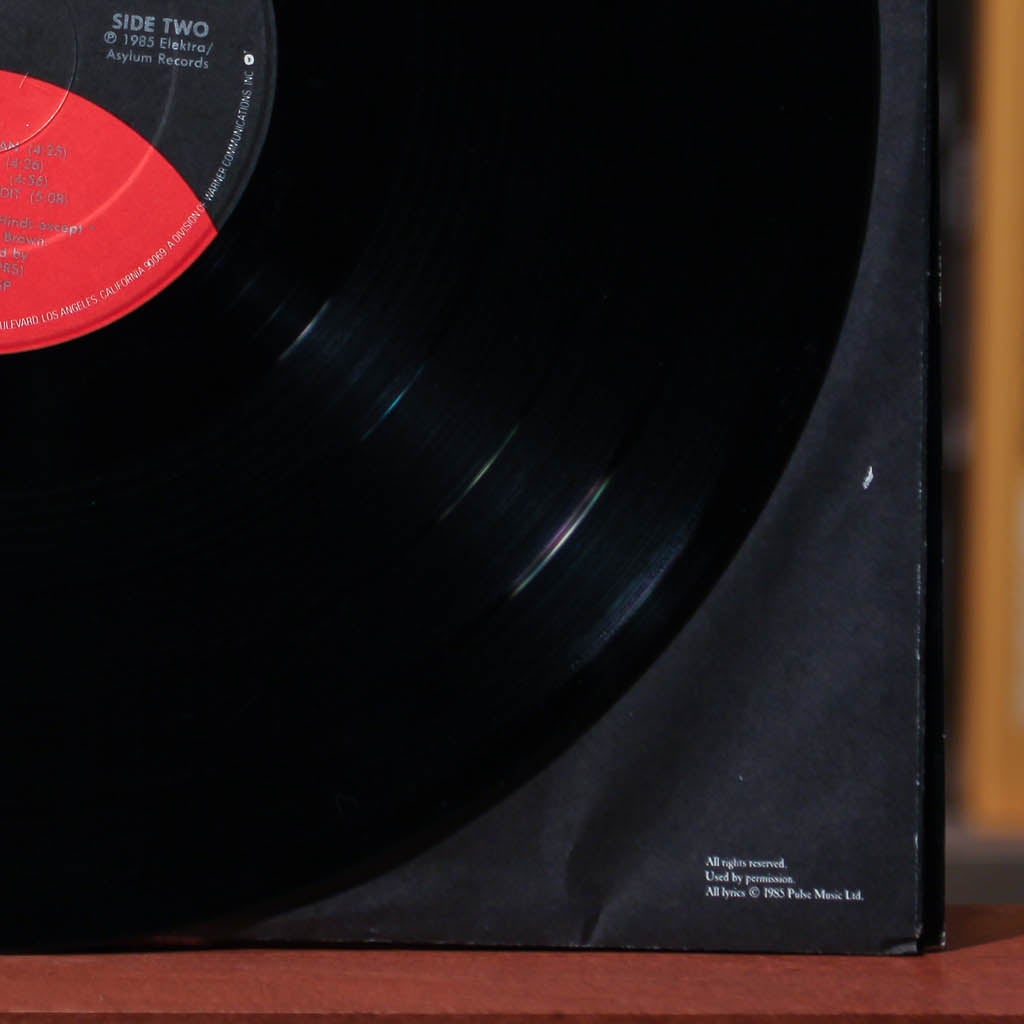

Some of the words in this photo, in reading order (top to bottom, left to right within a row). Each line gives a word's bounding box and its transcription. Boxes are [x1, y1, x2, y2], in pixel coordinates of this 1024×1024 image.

[112, 13, 155, 33] SIDE
[162, 18, 209, 38] TWO
[124, 34, 155, 48] 1985
[160, 37, 214, 55] Elektra/
[106, 49, 152, 64] Asylum
[158, 53, 209, 69] Records
[41, 309, 60, 323] LOS
[99, 266, 145, 300] CALIFORNIA
[174, 211, 202, 244] DIVISION
[204, 168, 226, 202] WARNER
[221, 90, 252, 168] COMMUNICATIONS
[39, 221, 83, 236] except
[13, 246, 28, 260] by
[706, 856, 719, 866] All
[722, 858, 746, 870] rights
[749, 858, 788, 869] reserved.
[705, 871, 729, 881] Used
[732, 872, 742, 885] by
[746, 875, 796, 886] permission.
[706, 887, 720, 897] All
[722, 888, 746, 900] lyrics
[764, 888, 785, 898] 1985
[788, 889, 812, 899] Pulse
[814, 889, 843, 900] Music
[845, 890, 864, 901] Ltd.
